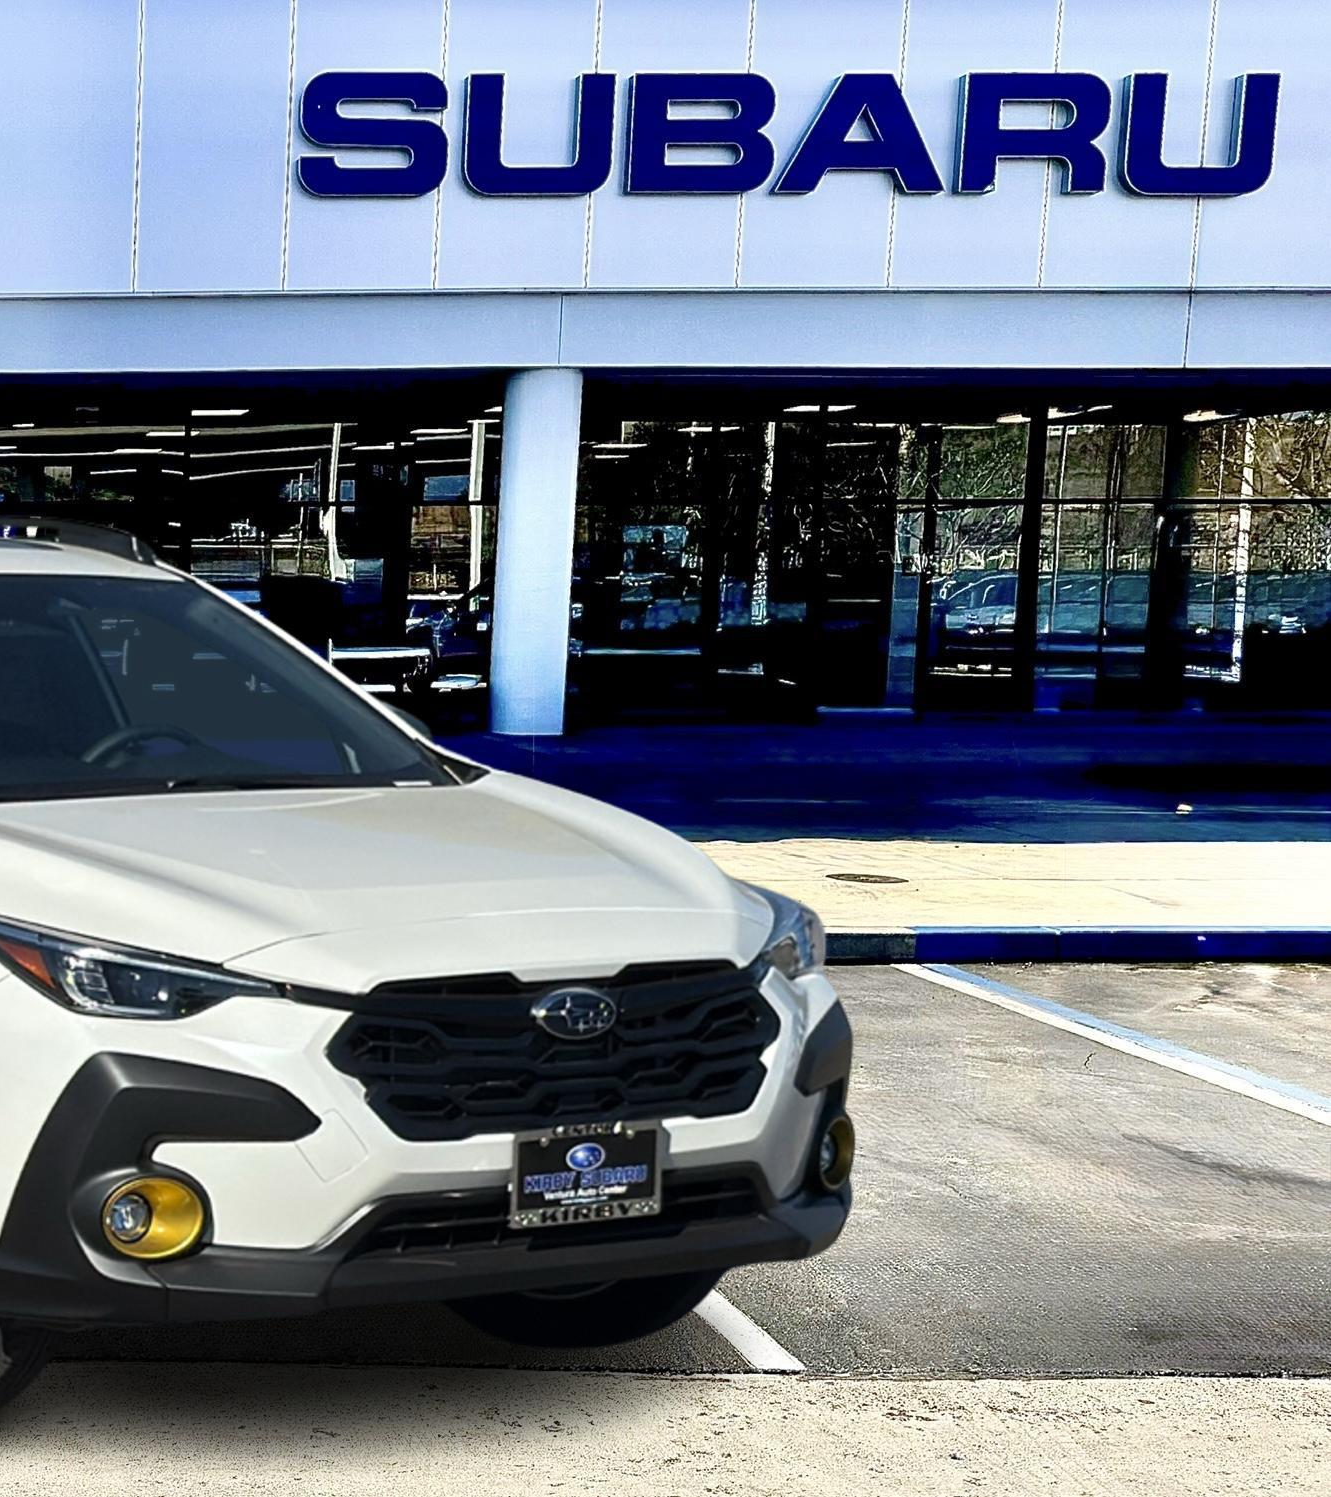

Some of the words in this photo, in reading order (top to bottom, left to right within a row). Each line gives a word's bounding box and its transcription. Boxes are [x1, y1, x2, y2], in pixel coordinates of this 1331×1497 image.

[297, 72, 1282, 198] SUBARU
[523, 1171, 576, 1194] KIRBY
[581, 1164, 648, 1187] SUBARU
[543, 1188, 575, 1200] Ventura
[576, 1186, 597, 1197] Auto
[598, 1184, 628, 1195] Center
[540, 1201, 632, 1223] KIRBY
